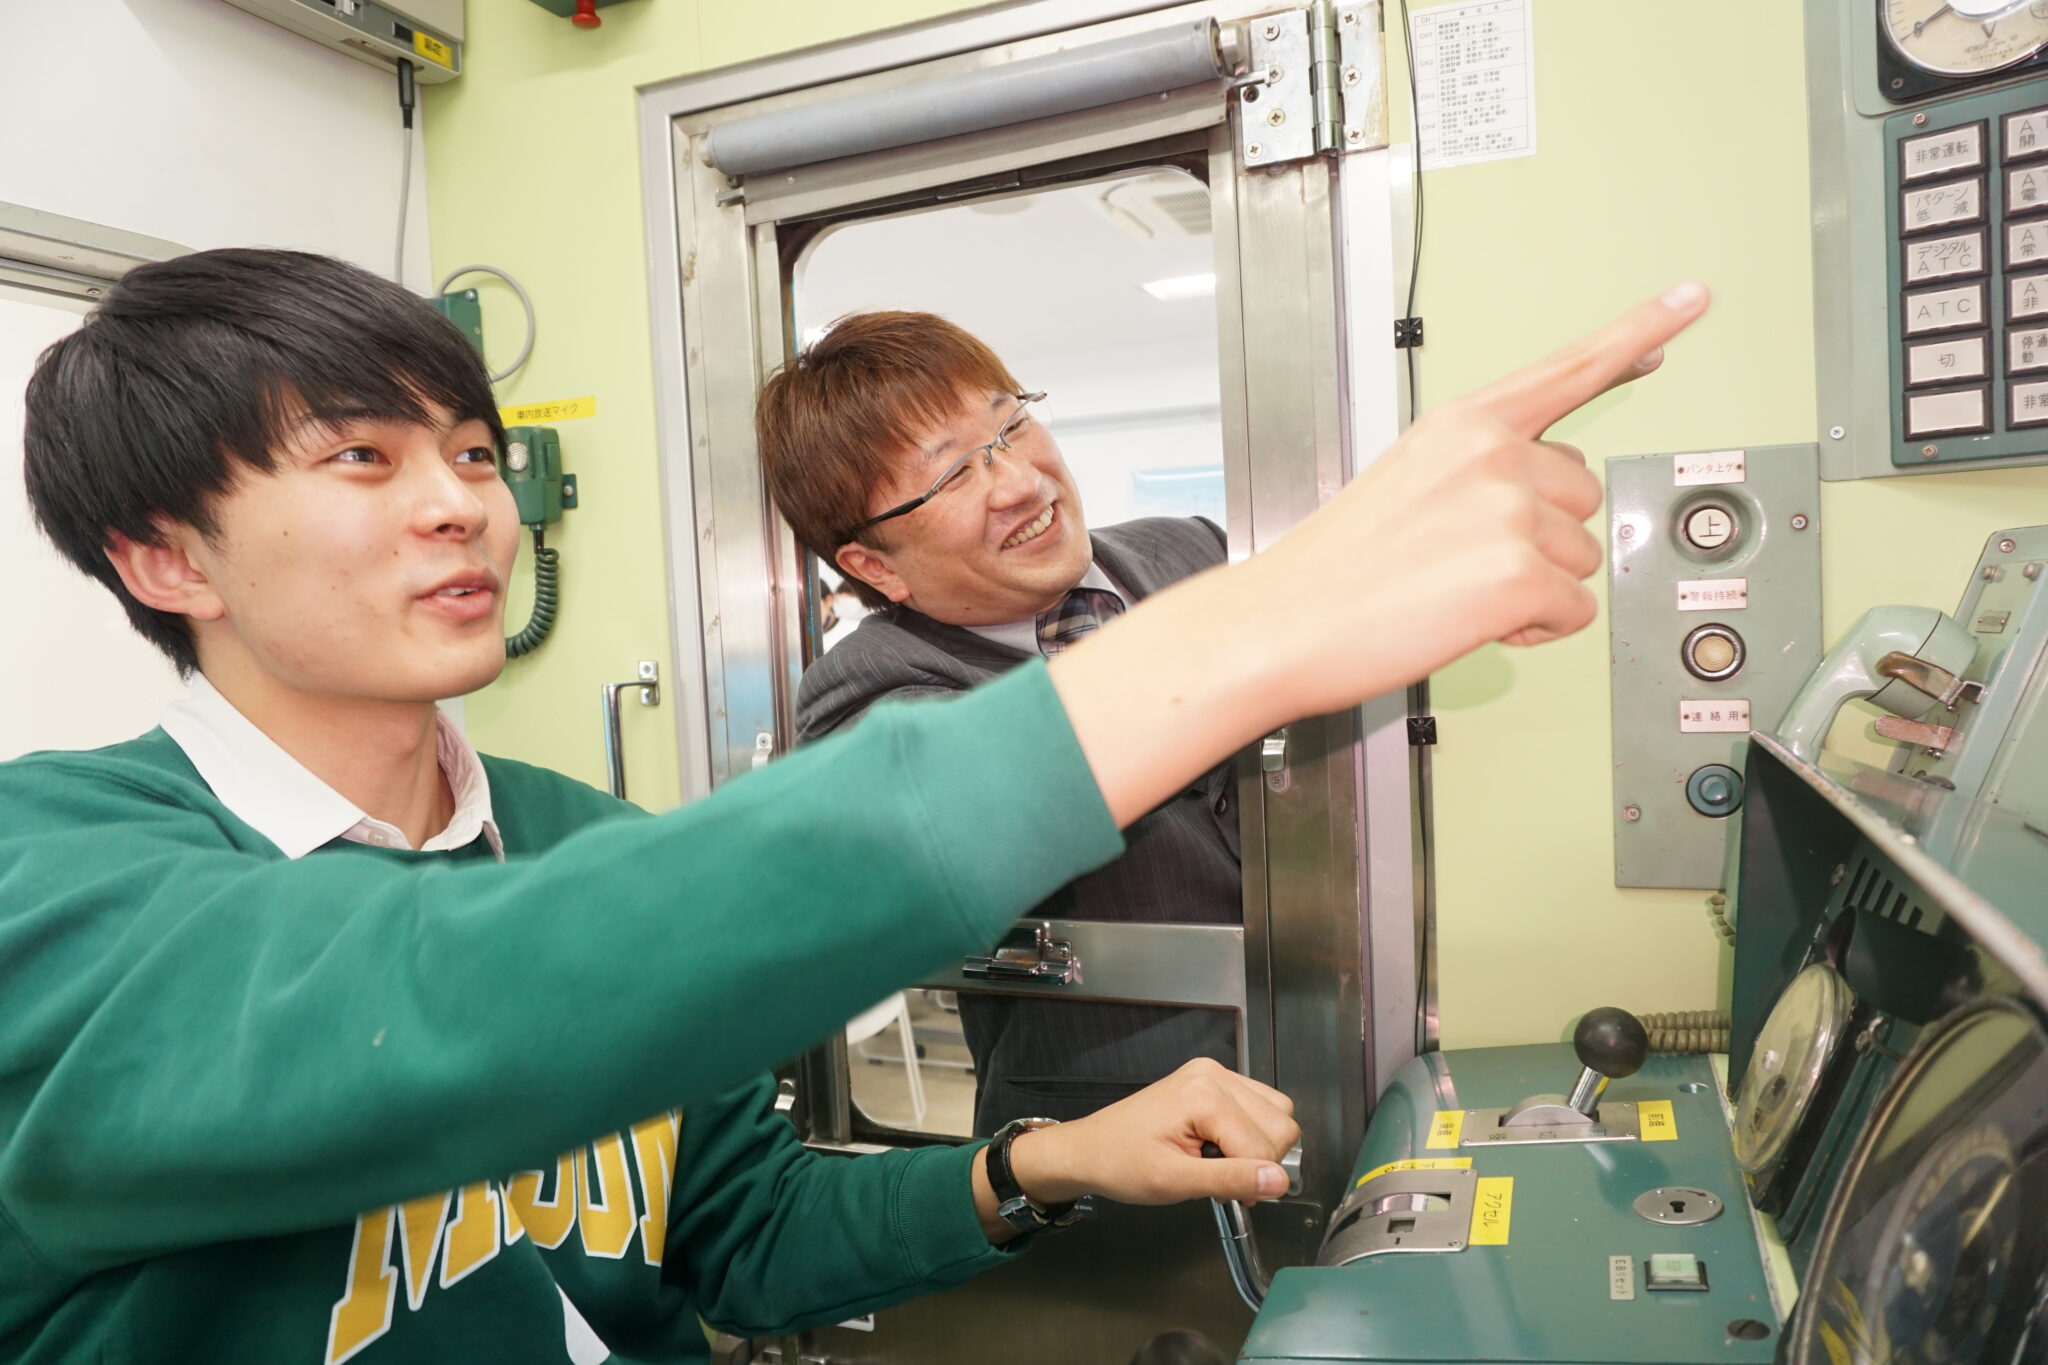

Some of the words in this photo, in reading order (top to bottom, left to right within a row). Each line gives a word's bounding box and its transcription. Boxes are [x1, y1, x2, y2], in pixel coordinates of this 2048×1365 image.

[1981, 22, 1997, 39] V
[1914, 140, 1970, 164] 非常運転
[1916, 186, 1969, 208] パターン
[1917, 240, 1972, 260] デジタル
[1917, 253, 1972, 274] ATC
[1917, 298, 1971, 320] ATC
[1938, 353, 1956, 368] 切
[1699, 515, 1723, 538] 上
[1691, 710, 1739, 723] 連絡用
[1482, 1192, 1503, 1227] アクセル
